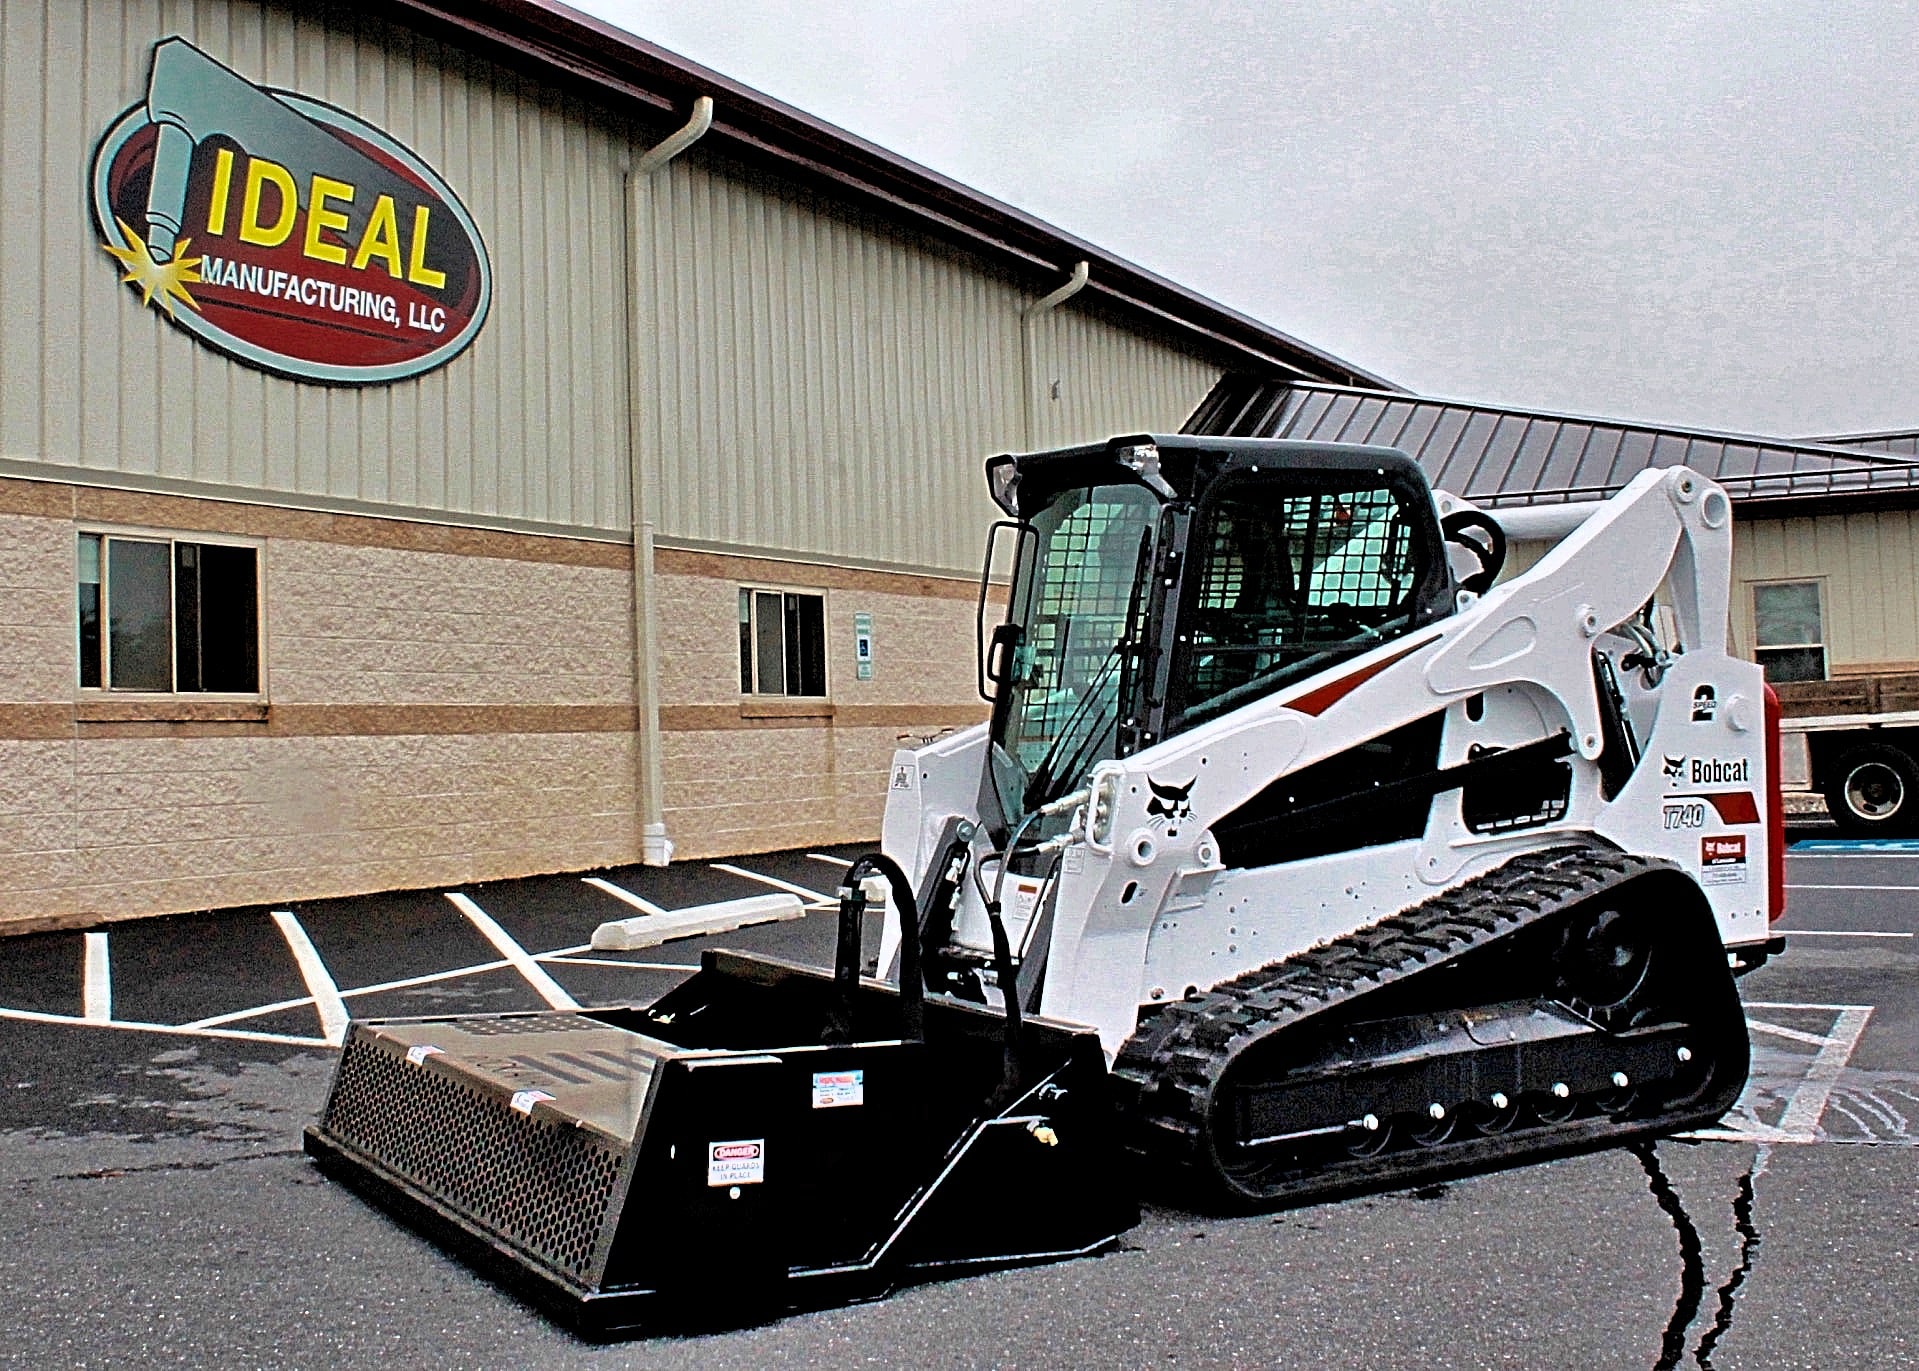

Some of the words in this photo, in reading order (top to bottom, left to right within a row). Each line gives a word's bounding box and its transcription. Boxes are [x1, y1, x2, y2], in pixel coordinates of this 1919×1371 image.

[207, 147, 447, 290] IDEAL
[201, 255, 401, 329] MANUFACTURING,
[408, 301, 447, 334] LLC
[1691, 684, 1715, 722] 2
[1693, 700, 1717, 709] SPEED
[1692, 757, 1749, 784] Bobcat
[1663, 803, 1705, 830] T740
[1716, 842, 1742, 855] Bobcat
[719, 1146, 753, 1158] DANGER
[712, 1163, 730, 1172] KEEP
[731, 1161, 760, 1171] GUARDS
[730, 1171, 751, 1180] PLACE
